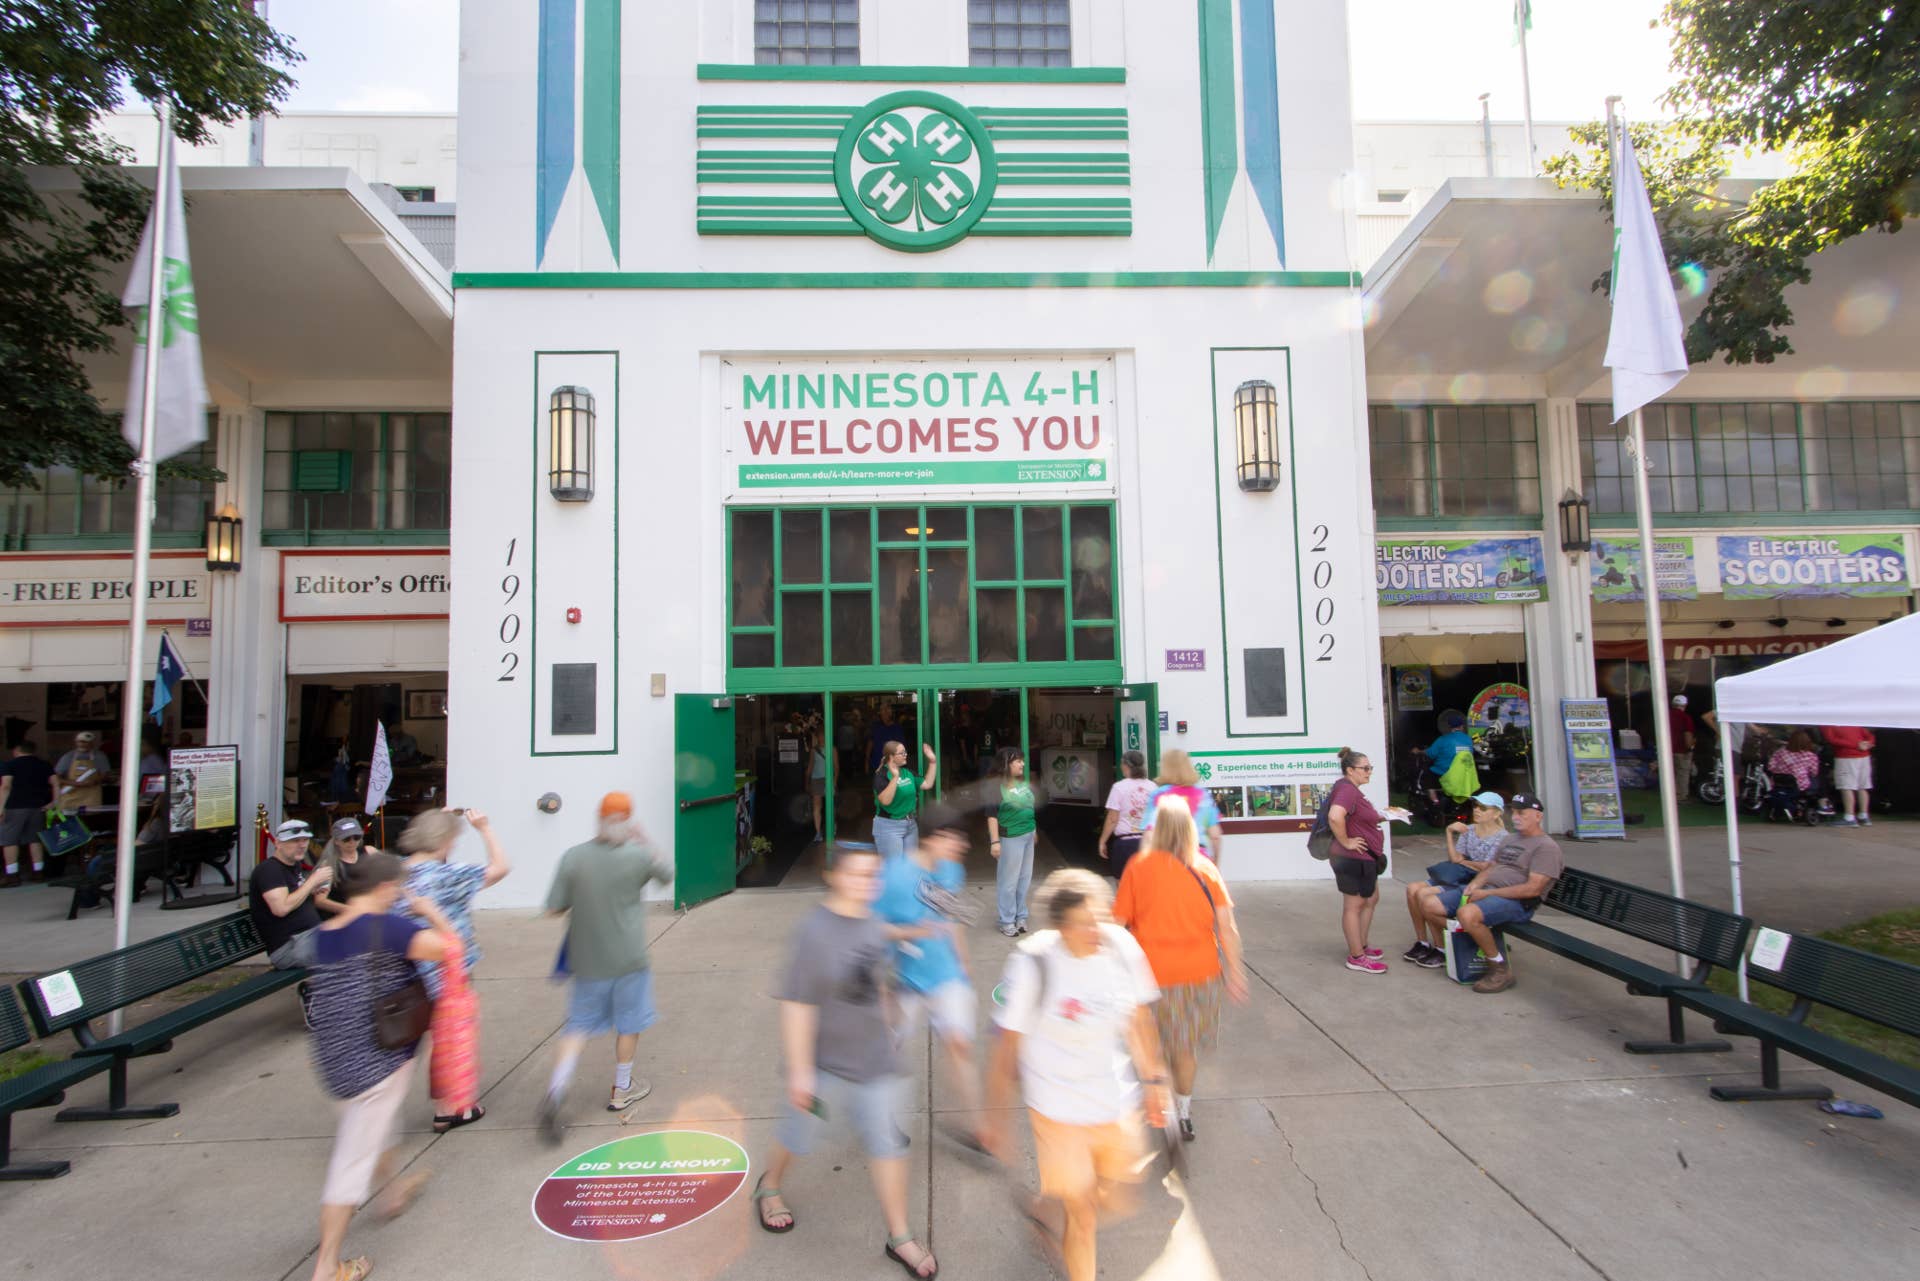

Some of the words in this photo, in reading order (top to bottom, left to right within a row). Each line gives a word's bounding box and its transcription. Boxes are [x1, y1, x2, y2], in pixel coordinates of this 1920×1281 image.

[743, 371, 1011, 409] MINNESOTA
[1023, 370, 1099, 406] 4-H
[743, 417, 999, 455] WELCOMES
[1012, 415, 1100, 451] YOU
[745, 469, 935, 481] extension.umn.edu/4-h/learn-more-or-join
[1018, 469, 1081, 480] EXTENSION
[1377, 546, 1447, 561] ELECTRIC
[1748, 540, 1840, 556] ELECTRIC
[1725, 556, 1902, 586] SCOOTERS
[13, 582, 82, 601] FREE
[294, 576, 393, 595] Editor's
[400, 575, 451, 593] Offi
[1310, 524, 1335, 662] 2002
[497, 538, 520, 682] 1902
[1173, 652, 1199, 662] 1412
[1217, 763, 1268, 773] Experience
[1270, 762, 1284, 770] the
[1287, 761, 1303, 769] 4-H
[1554, 875, 1633, 922] ALTH
[576, 1162, 612, 1171] DID
[618, 1161, 656, 1170] YOU
[660, 1158, 732, 1169] KNOW?
[576, 1182, 639, 1190] Minnesota
[668, 1180, 678, 1188] is
[680, 1179, 707, 1188] part
[576, 1191, 589, 1199] of
[617, 1189, 679, 1199] University
[682, 1187, 697, 1195] of
[563, 1199, 629, 1207] Minnesota
[631, 1197, 697, 1206] Extension.
[571, 1218, 643, 1227] EXTENSION
